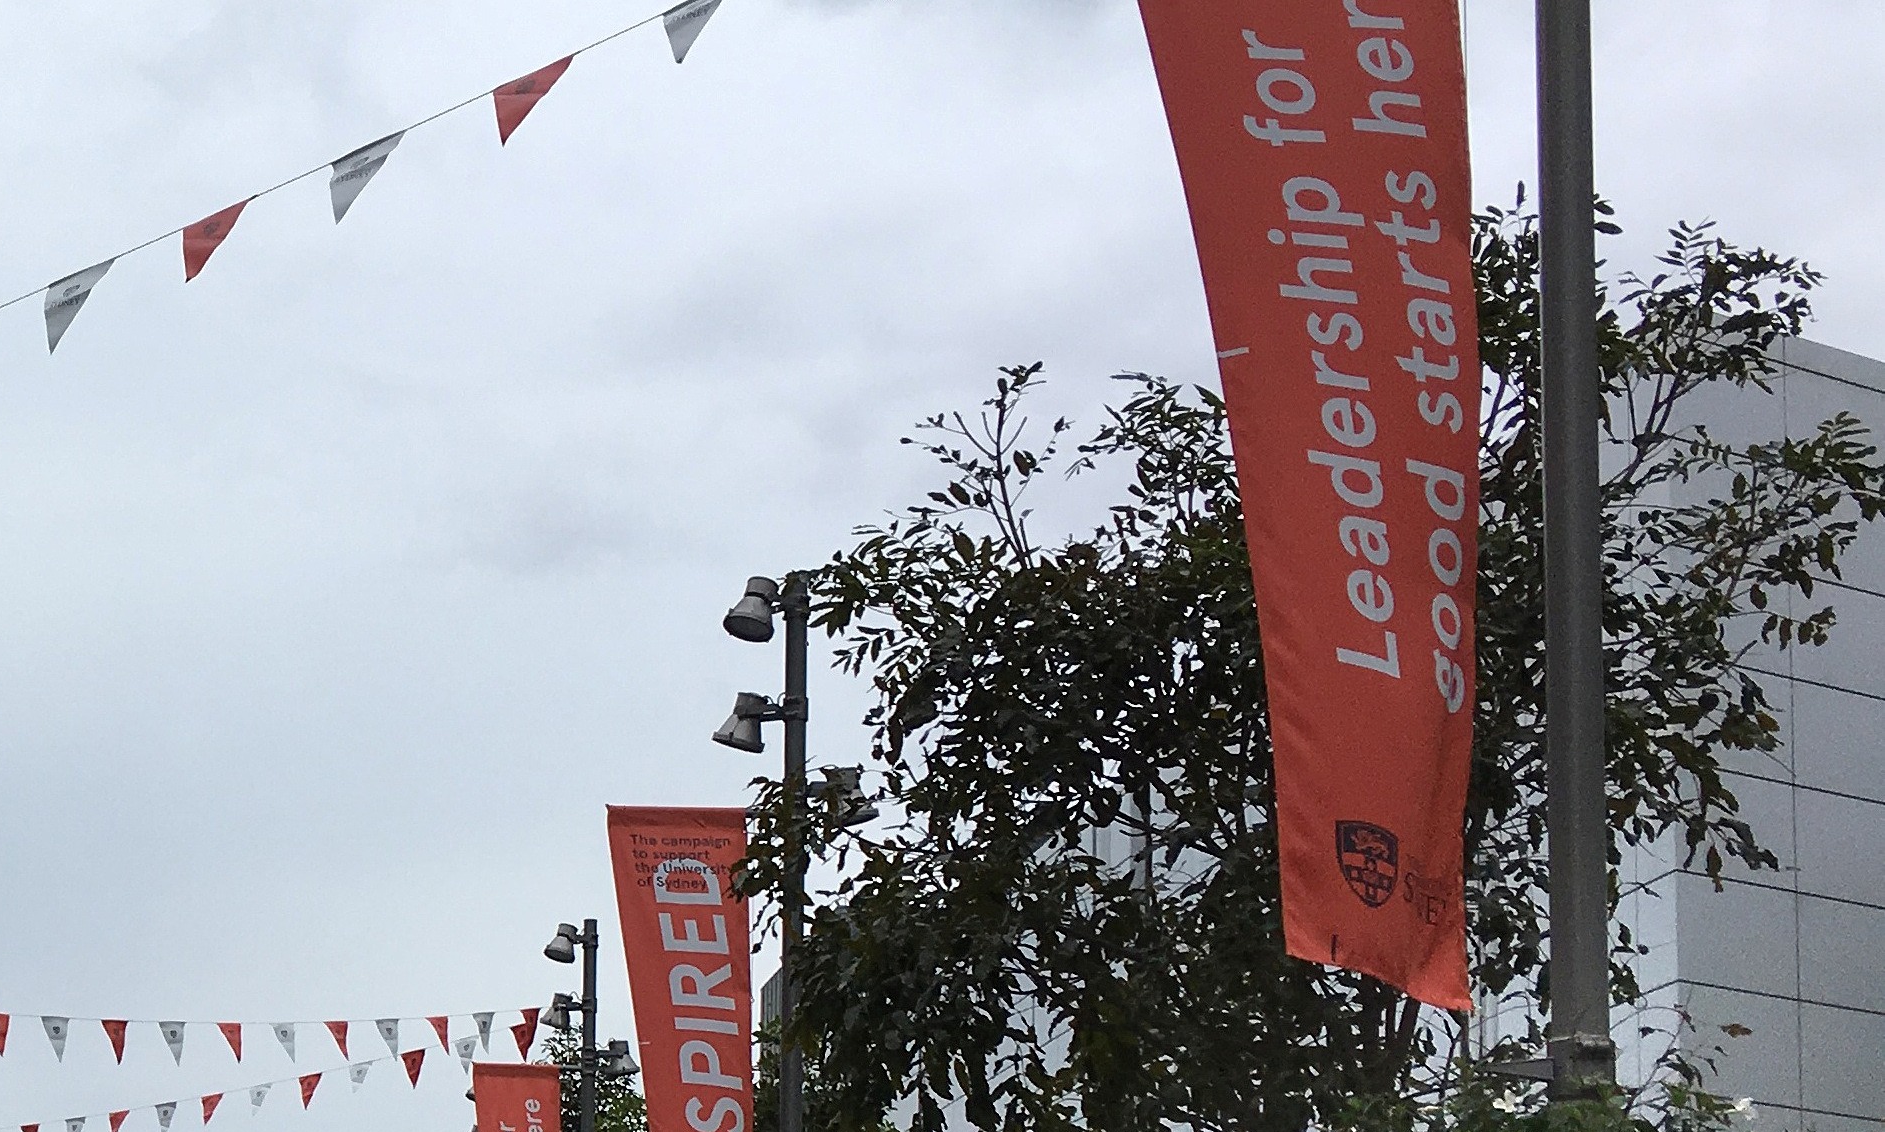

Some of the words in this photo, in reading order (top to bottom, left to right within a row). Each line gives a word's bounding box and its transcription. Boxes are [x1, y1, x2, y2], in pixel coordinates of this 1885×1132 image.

[1241, 29, 1327, 146] for
[1374, 170, 1463, 434] starts
[1267, 176, 1401, 679] Leadership
[1405, 458, 1465, 713] good
[630, 834, 658, 845] The
[661, 836, 731, 849] campaign
[632, 849, 648, 859] to
[653, 850, 710, 863] support
[635, 862, 658, 873] the
[637, 876, 653, 887] of
[656, 876, 707, 890] Sydney
